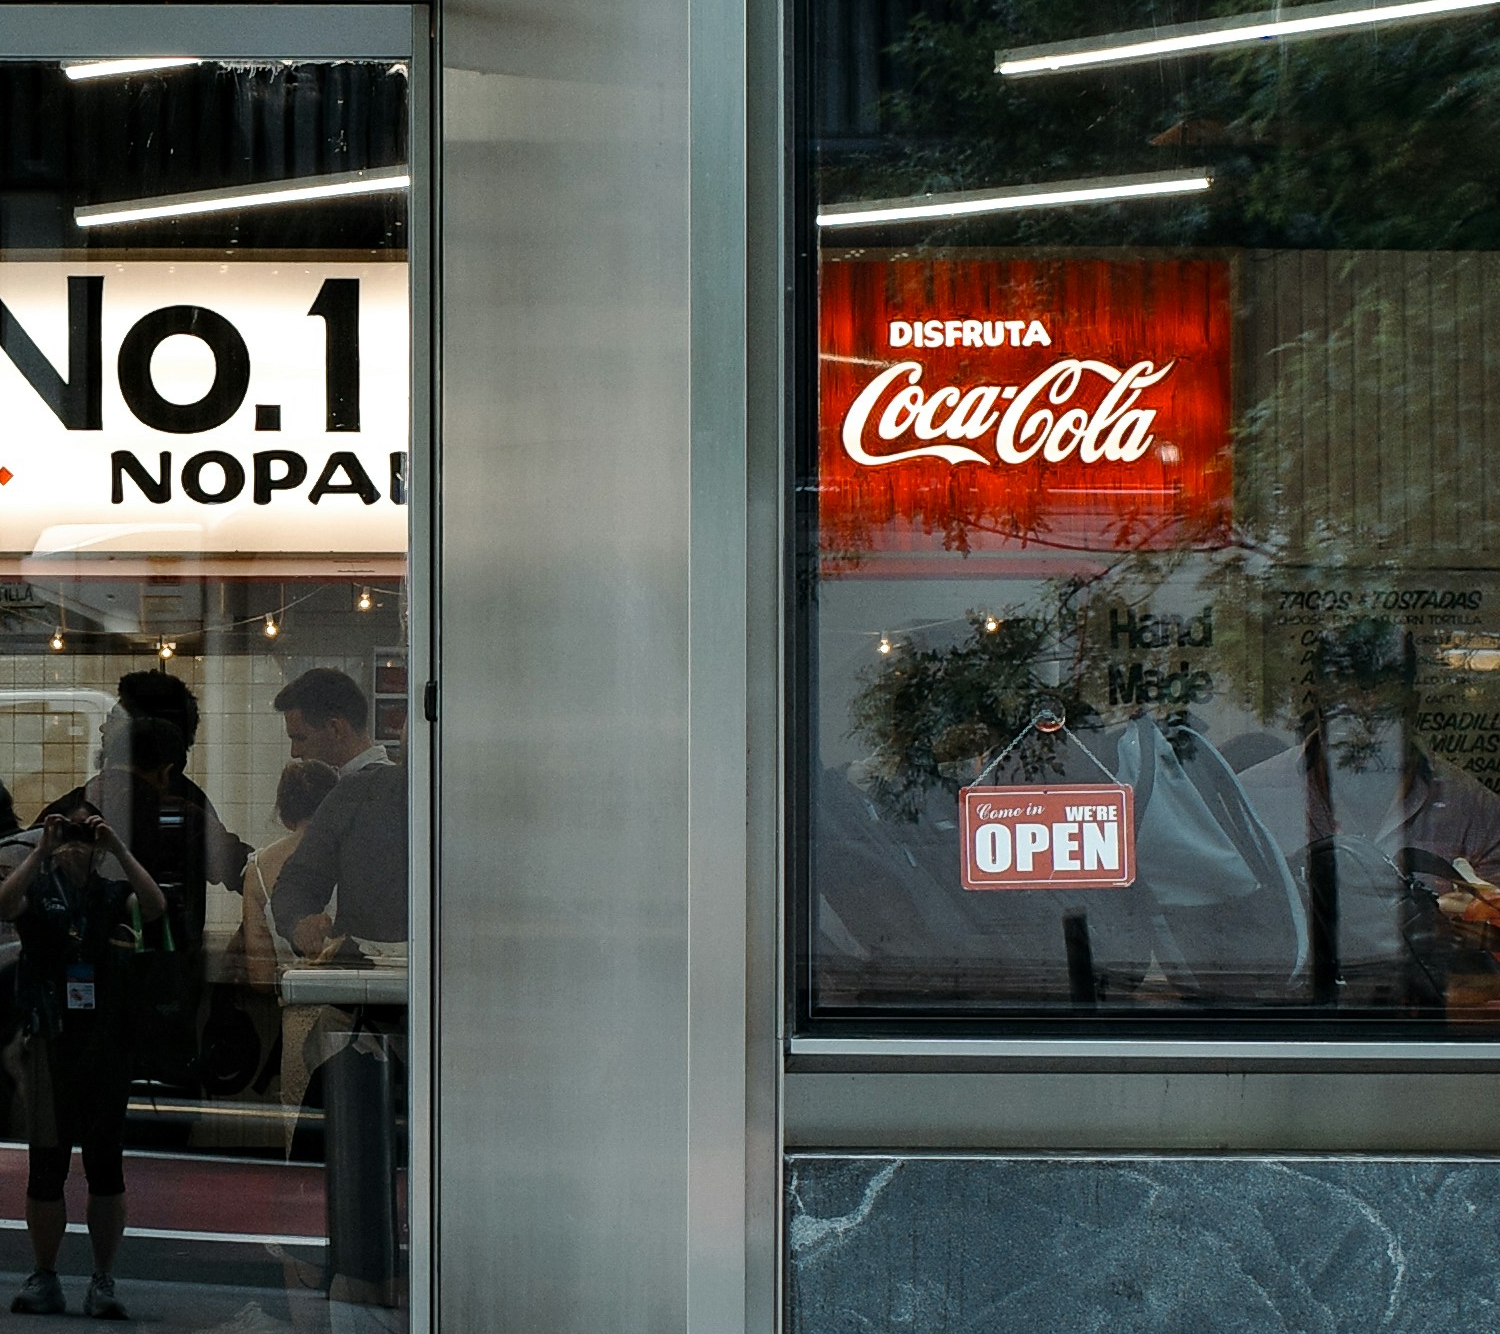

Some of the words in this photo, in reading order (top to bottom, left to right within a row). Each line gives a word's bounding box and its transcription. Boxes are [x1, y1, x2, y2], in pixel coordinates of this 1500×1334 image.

[889, 320, 1052, 348] DISFRUTA
[842, 358, 1178, 467] Coca-Cola
[1279, 590, 1353, 610] TACOS
[1371, 590, 1482, 610] TOSTADAS
[1110, 606, 1213, 649] Hand
[1108, 661, 1214, 706] Made
[1432, 734, 1500, 754] MULAS
[976, 803, 1023, 821] Come
[1025, 803, 1046, 817] in
[1064, 805, 1119, 822] WE'RE
[975, 822, 1120, 874] OPEN
